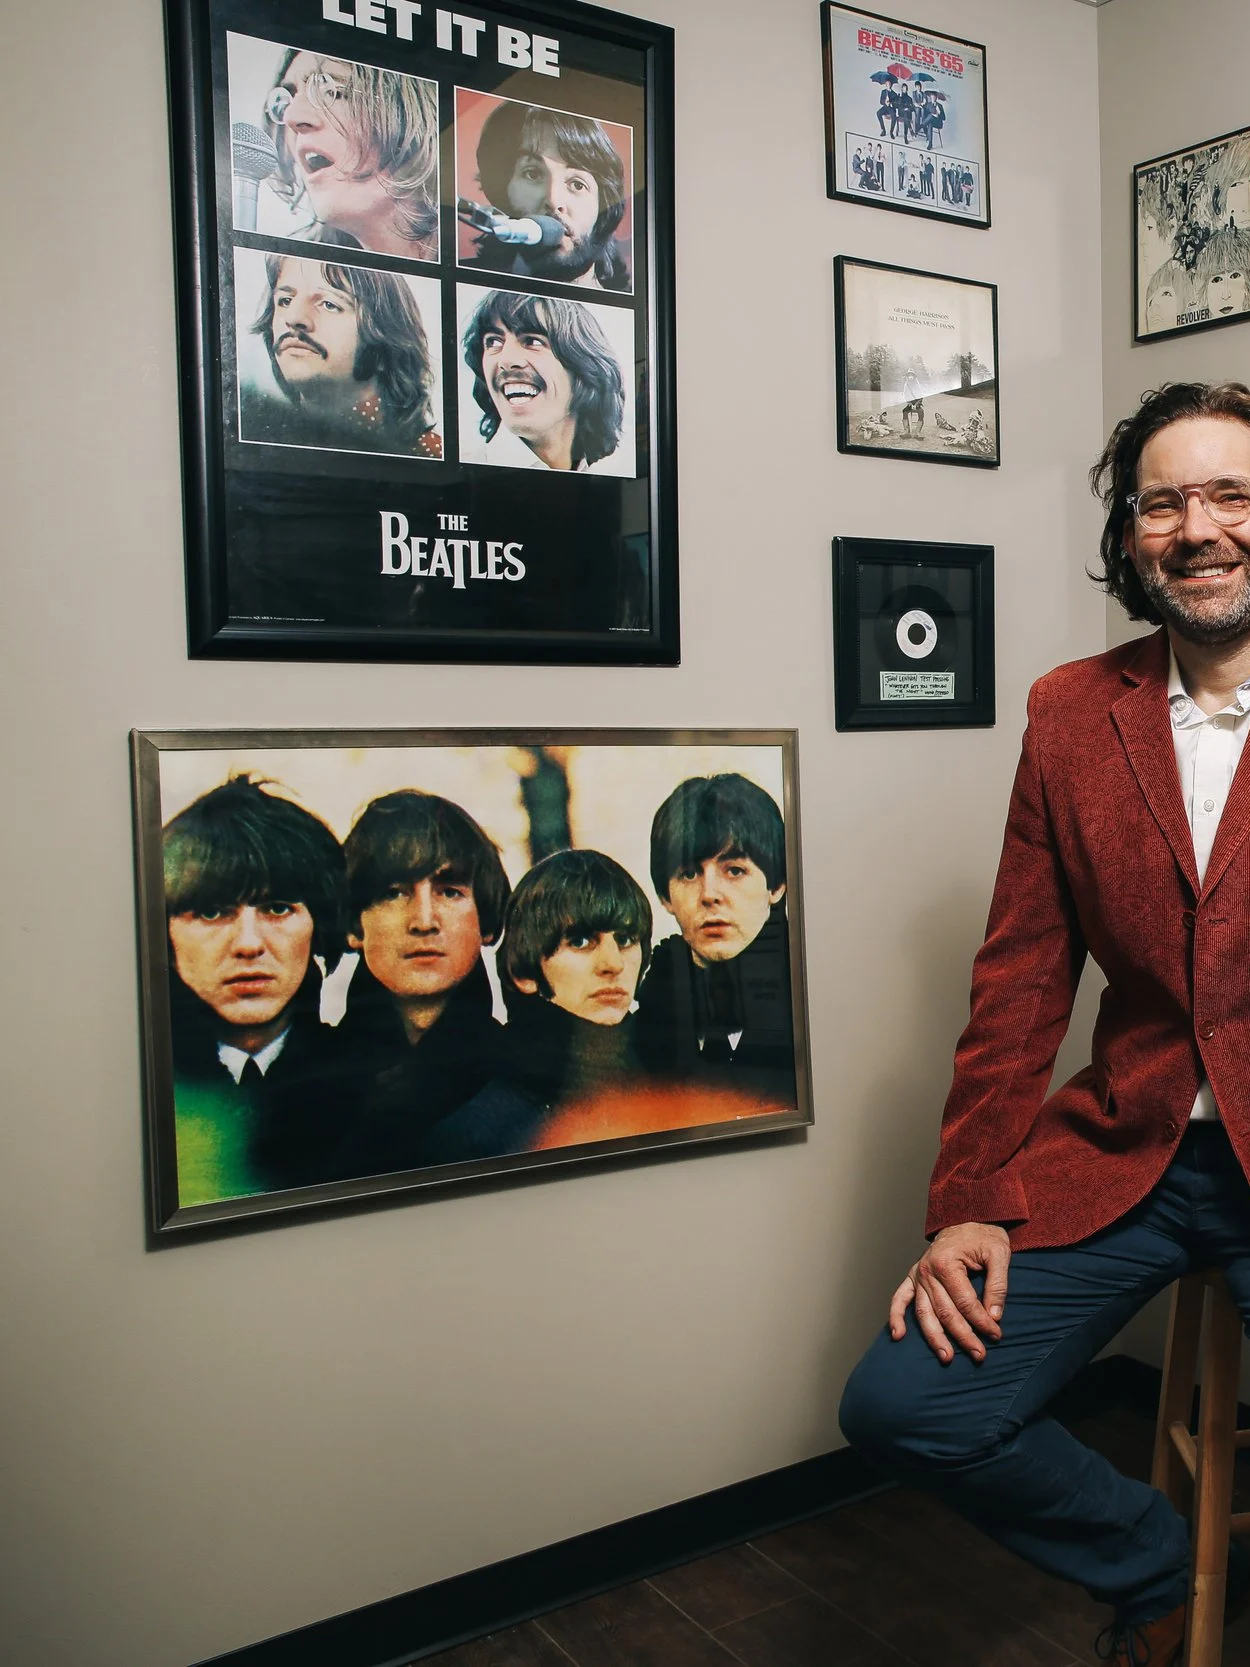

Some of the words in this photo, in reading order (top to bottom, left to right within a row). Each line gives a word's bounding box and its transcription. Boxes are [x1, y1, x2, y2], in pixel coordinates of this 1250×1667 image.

[322, 0, 422, 41] LET
[436, 9, 486, 57] IT
[497, 24, 560, 78] BE
[857, 29, 935, 65] BEATLES
[935, 52, 964, 73] '65
[1176, 308, 1210, 326] REVOLVER
[437, 513, 469, 531] THE
[379, 510, 526, 589] BEATLES
